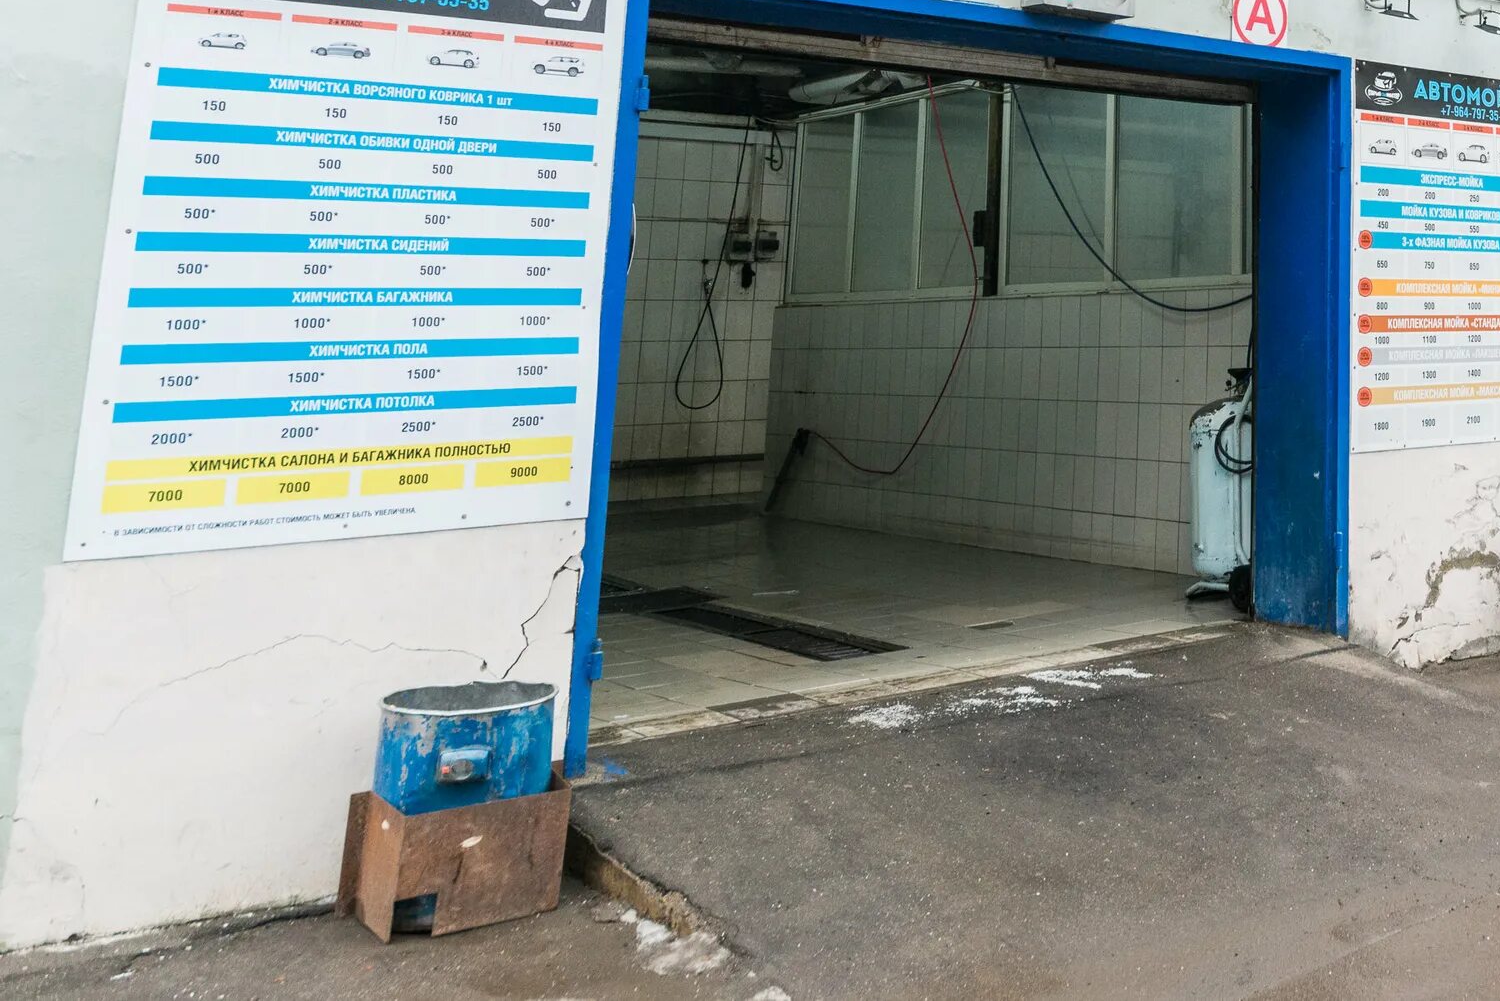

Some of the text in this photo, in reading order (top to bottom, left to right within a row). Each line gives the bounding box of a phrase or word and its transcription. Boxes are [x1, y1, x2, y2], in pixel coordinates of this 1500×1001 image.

[219, 9, 244, 17] КЛАСС
[340, 19, 363, 27] КЛАСС
[269, 78, 512, 106] ХИМЧИСТКА ВОРСЯНОГО КОВРИКА 1 шт
[202, 101, 226, 111] 150
[325, 108, 347, 119] 150
[438, 115, 458, 126] 150
[542, 122, 561, 132] 150
[276, 131, 497, 154] ХИМЧИСТКА ОБИВКИ ОДНОЙ ДВЕРИ
[195, 153, 219, 165] 500
[319, 159, 341, 170] 500
[432, 164, 453, 175] 500
[537, 169, 557, 180] 500
[1421, 173, 1483, 188] ЭКСПРЕСС-МОЙКА
[310, 185, 457, 202] ХИМЧИСТКА ПЛАСТИКА
[1469, 195, 1479, 203] 250
[1402, 205, 1500, 221] МОЙКА КУЗОВА И КОВРИКОВ
[1378, 221, 1388, 229] 450
[1425, 223, 1435, 231] 500
[308, 237, 449, 252] ХИМЧИСТКА СИДЕНИЙ
[1402, 237, 1500, 250] 3-х ФАЗНАЯ МОЙКА КУЗОВА
[1377, 260, 1388, 268] 650
[1425, 261, 1435, 269] 750
[1396, 283, 1450, 294] КОМПЛЕКСНАЯ
[1452, 282, 1477, 294] МОЙКА
[292, 291, 453, 304] ХИМЧИСТКА БАГАЖНИКА
[1376, 302, 1388, 310] 800
[1424, 302, 1435, 310] 900
[1468, 302, 1481, 310] 1000
[1388, 318, 1442, 329] КОМПЛЕКСНАЯ
[1444, 316, 1469, 328] МОЙКА
[1375, 337, 1389, 345] 1000
[1468, 335, 1481, 343] 1200
[309, 343, 428, 357] ХИМЧИСТКА ПОЛА
[1389, 350, 1443, 361] КОМПЛЕКСНАЯ
[1445, 348, 1470, 359] МОЙКА
[1375, 373, 1389, 381] 1200
[1423, 371, 1436, 379] 1300
[1468, 369, 1481, 377] 1400
[1394, 388, 1448, 401] КОМПЛЕКСНАЯ
[1450, 386, 1474, 399] МОЙКА
[290, 395, 435, 413] ХИМЧИСТКА ПОТОЛКА
[1422, 419, 1435, 427] 1900
[1467, 416, 1480, 424] 2100
[1374, 422, 1389, 430] 1800
[189, 442, 511, 472] ХИМЧИСТКА САЛОНА И БАГАЖНИКА ПОЛНОСТЬЮ
[510, 466, 538, 478] 9000
[399, 473, 428, 485] 8000
[279, 481, 310, 494] 7000
[148, 490, 183, 502] 7000
[122, 525, 183, 535] ЗАВИСИМОСТИ
[197, 520, 248, 530] СЛОЖНОСТИ
[249, 518, 274, 526] РАБОТ
[276, 515, 321, 524] СТОИМОСТЬ
[323, 512, 350, 520] МОЖЕТ
[375, 507, 416, 517] УВЕЛИЧЕНА
